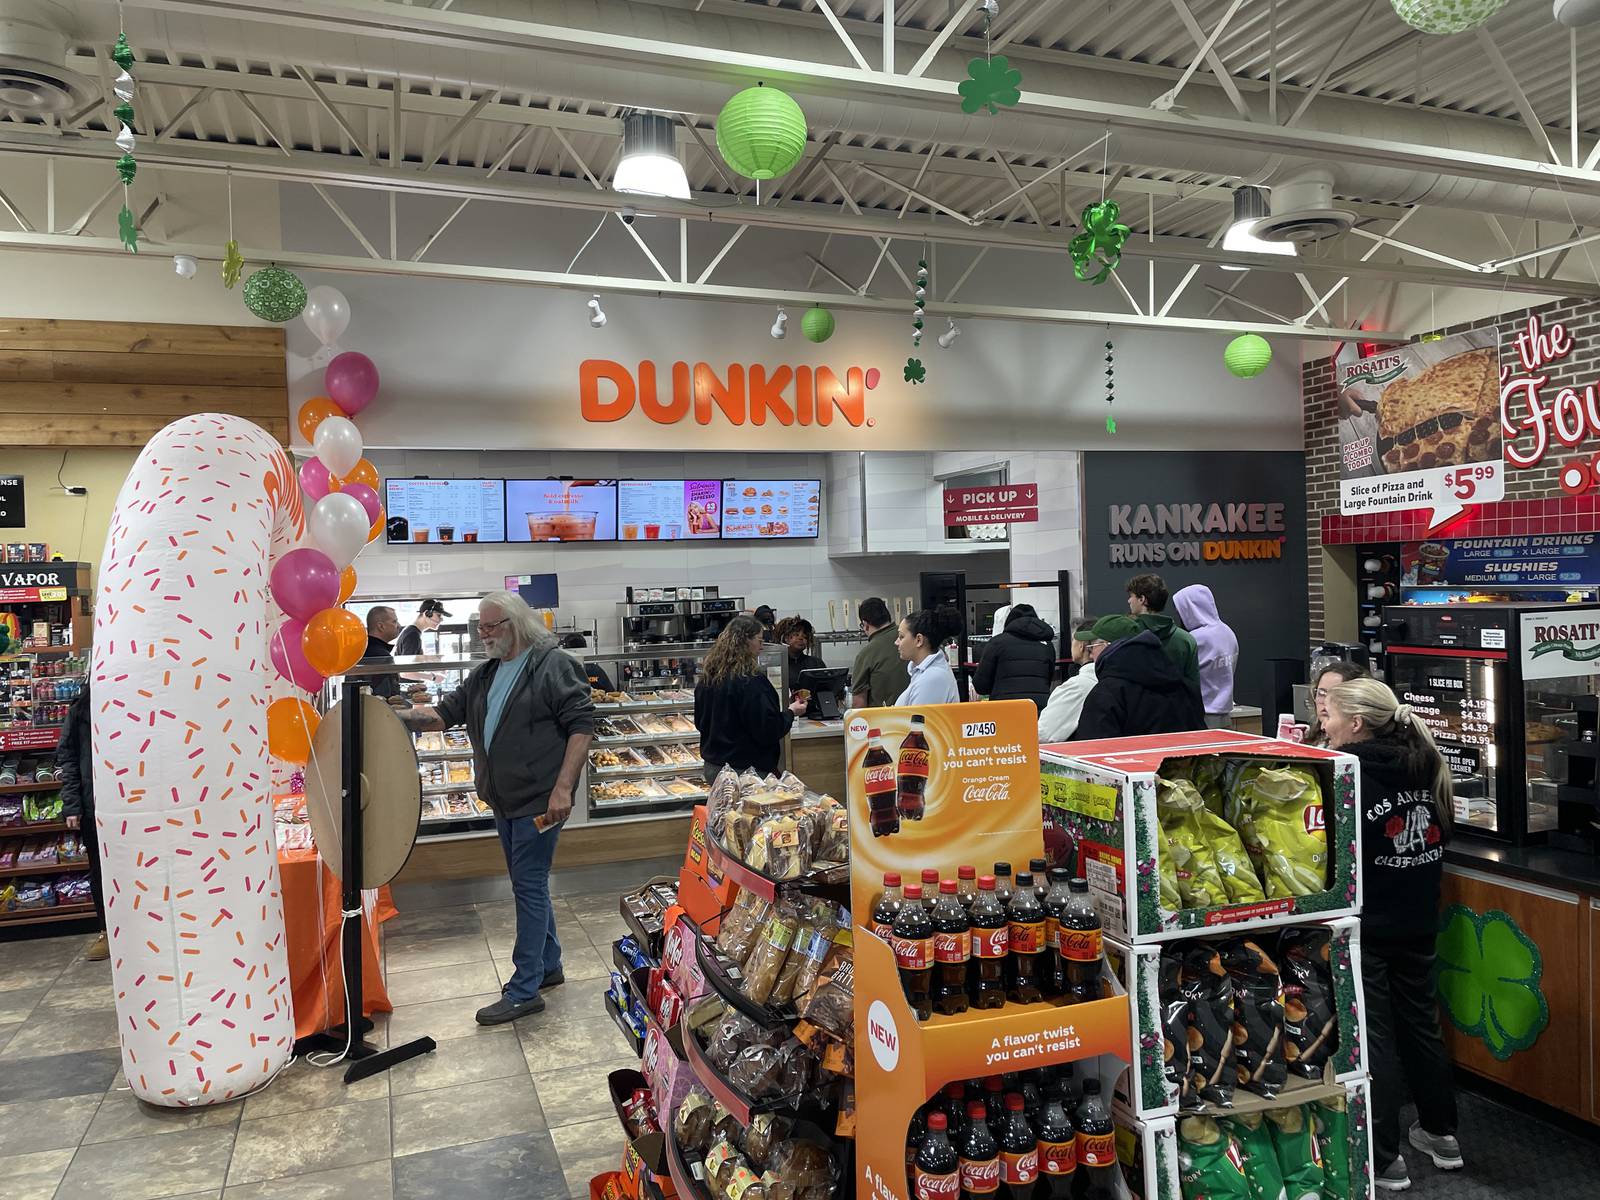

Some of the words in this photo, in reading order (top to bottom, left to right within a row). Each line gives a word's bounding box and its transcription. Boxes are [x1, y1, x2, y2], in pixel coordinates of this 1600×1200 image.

[1515, 315, 1574, 371] the
[1346, 355, 1401, 378] ROSATI'S
[579, 358, 881, 427] DUNKIN'
[1344, 442, 1359, 453] PICK
[1360, 437, 1370, 446] UP
[1343, 455, 1349, 464] A
[1349, 446, 1373, 461] COMBO
[1347, 457, 1373, 472] TODAY!
[1350, 485, 1369, 497] Slice
[1370, 484, 1380, 494] of
[1382, 482, 1405, 493] Pizza
[1406, 479, 1424, 490] and
[962, 492, 996, 504] PICK
[998, 490, 1018, 502] UP
[1343, 497, 1367, 510] Large
[1368, 494, 1406, 506] Fountain
[1408, 491, 1433, 502] Drink
[956, 514, 982, 522] MOBILE
[991, 512, 1026, 520] DELIVERY
[1109, 503, 1286, 535] KANKAKEE
[1453, 539, 1528, 549] FOUNTAIN
[1531, 535, 1595, 546] DRINKS
[1109, 542, 1166, 563] RUNS
[1167, 541, 1200, 561] ON
[1522, 548, 1529, 556] X
[1530, 547, 1560, 555] LARGE
[1484, 561, 1559, 573] SLUSHIES
[2, 573, 60, 586] VAPOR
[1432, 678, 1446, 688] SLICE
[1453, 680, 1464, 689] BOX
[1403, 692, 1435, 703] Cheese
[1460, 699, 1487, 709] $4.19
[1411, 706, 1440, 716] ausage
[1461, 710, 1487, 721] $4.39
[850, 725, 868, 733] NEW
[1461, 722, 1489, 733] $4.39
[1432, 729, 1458, 740] Pizza
[1461, 734, 1490, 745] $29.99
[947, 749, 955, 757] A
[959, 746, 990, 756] flavor
[992, 744, 1022, 753] twist
[943, 760, 964, 770] you
[966, 756, 993, 767] can't
[995, 754, 1028, 765] resist
[962, 776, 986, 784] Orange
[1366, 798, 1392, 822] LOS
[870, 1019, 897, 1052] NEW
[991, 1038, 1000, 1049] A
[1002, 1031, 1040, 1047] flavor
[1042, 1024, 1075, 1040] twist
[986, 1052, 1010, 1065] you
[1013, 1044, 1043, 1058] can't
[1046, 1036, 1081, 1053] resist
[865, 1165, 873, 1184] A
